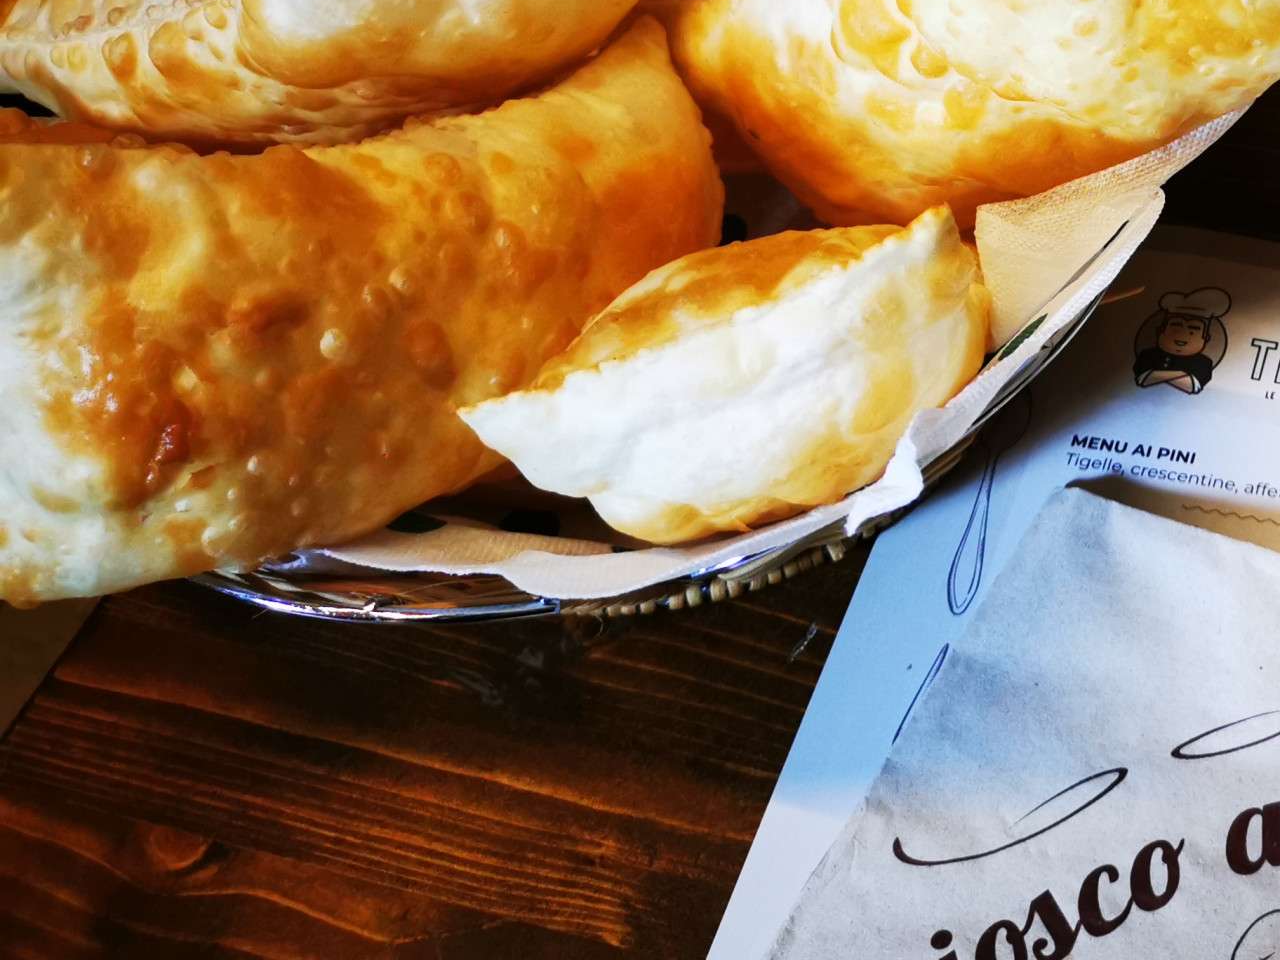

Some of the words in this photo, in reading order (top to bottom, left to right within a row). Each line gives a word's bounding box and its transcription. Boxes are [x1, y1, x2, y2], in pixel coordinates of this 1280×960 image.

[1265, 391, 1275, 400] LE
[1070, 434, 1129, 454] MENU
[1132, 443, 1153, 458] AI
[1156, 446, 1197, 465] PINI
[1065, 451, 1126, 477] Tigelle,
[1130, 463, 1239, 495] crescentine,
